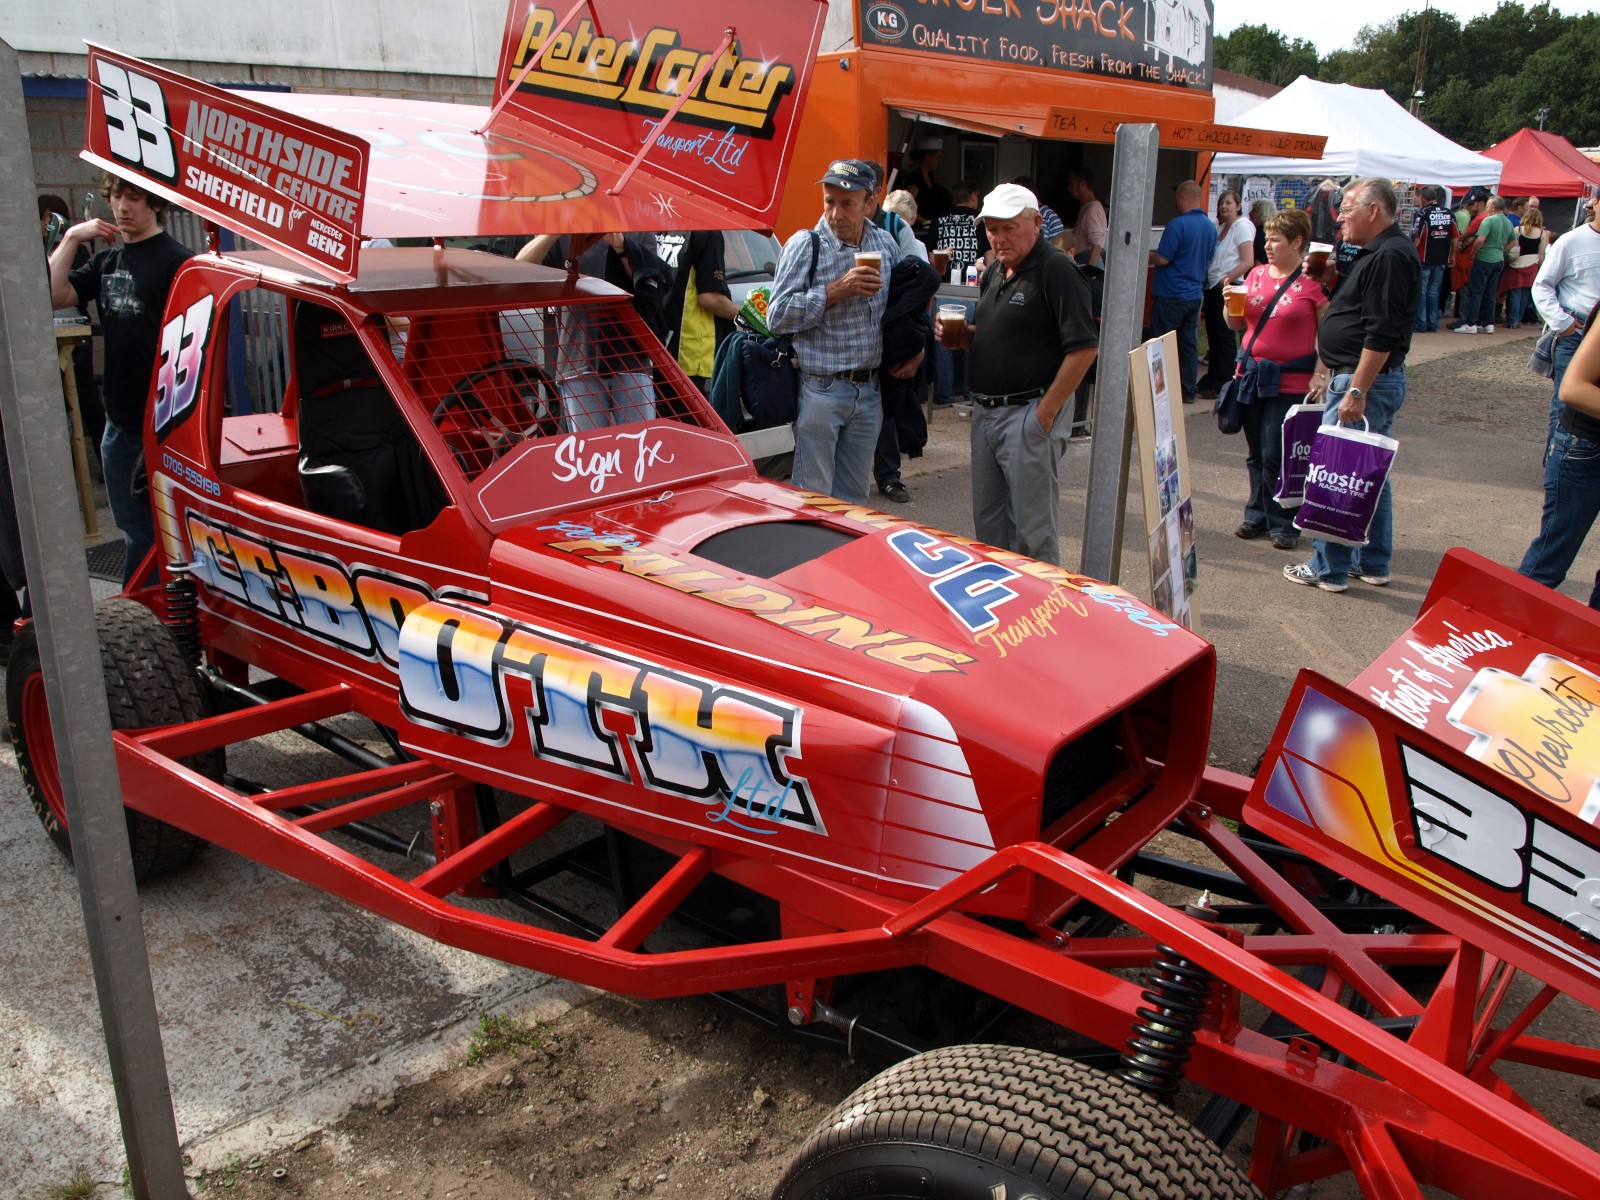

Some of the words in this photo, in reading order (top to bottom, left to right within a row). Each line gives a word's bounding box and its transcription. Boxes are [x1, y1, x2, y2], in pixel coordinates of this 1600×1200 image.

[509, 7, 637, 90] Peter
[912, 23, 989, 55] QUALITY
[1000, 37, 1045, 65] FOOD,
[1052, 45, 1095, 69] FRESH
[1101, 52, 1133, 75] FROM
[1138, 62, 1160, 79] THE
[1166, 63, 1207, 87] SHACK!
[96, 58, 179, 187] 33
[182, 100, 362, 200] NORTHSIDE
[640, 119, 715, 158] Tansport
[704, 126, 749, 174] Ltd
[1053, 114, 1077, 132] TEA
[1173, 127, 1192, 140] HOT
[1199, 130, 1253, 147] CHOCOLATE
[1270, 137, 1291, 149] COLD
[1294, 140, 1324, 152] DRINKS
[185, 165, 284, 229] SHEFFIELD
[288, 202, 307, 231] for
[207, 142, 272, 184] TRUCK
[275, 172, 358, 224] CENTRE
[310, 219, 343, 241] MERCEDES
[937, 225, 977, 239] FASTER
[937, 237, 979, 251] HARDER
[1429, 213, 1451, 221] Office
[307, 230, 347, 260] BENZ
[950, 250, 978, 263] UDER
[322, 323, 349, 333] KIRKE
[153, 293, 214, 444] 33
[551, 435, 625, 494] Sign
[1305, 462, 1376, 494] Hoosier
[1318, 482, 1348, 495] RACING
[1349, 489, 1367, 499] TIRE
[974, 582, 1089, 658] Transport
[1405, 620, 1513, 673] America
[1493, 675, 1600, 803] Chevrolet
[706, 766, 794, 835] Ltd
